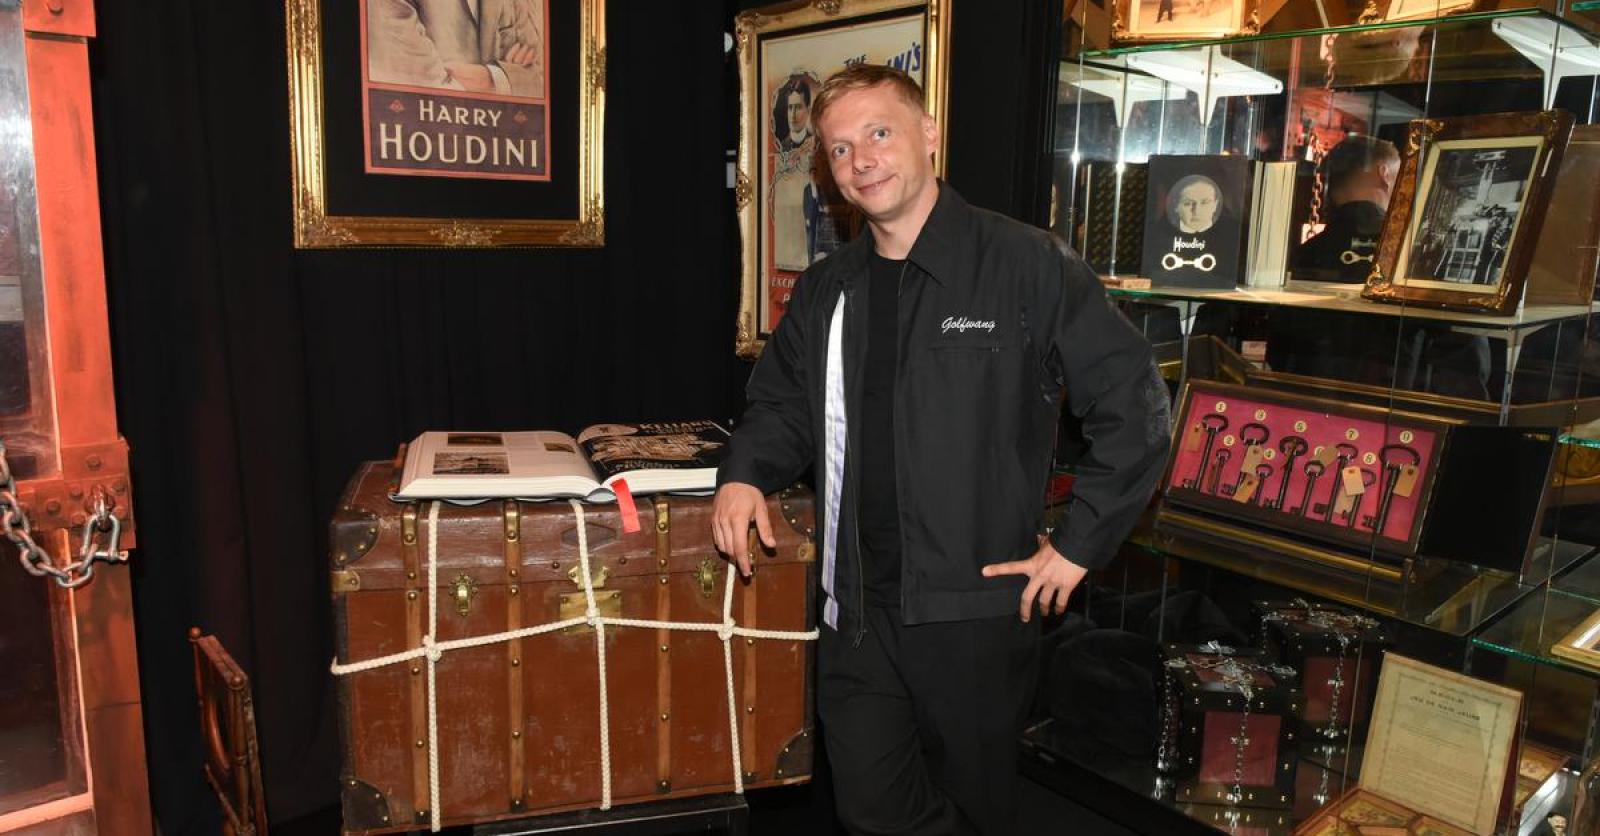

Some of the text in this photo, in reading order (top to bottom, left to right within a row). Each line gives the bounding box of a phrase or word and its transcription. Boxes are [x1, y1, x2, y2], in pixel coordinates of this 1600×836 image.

[418, 99, 502, 128] HARRY
[379, 122, 538, 169] HOUDINI
[1173, 235, 1206, 253] Houdini
[941, 316, 996, 334] Golfwang
